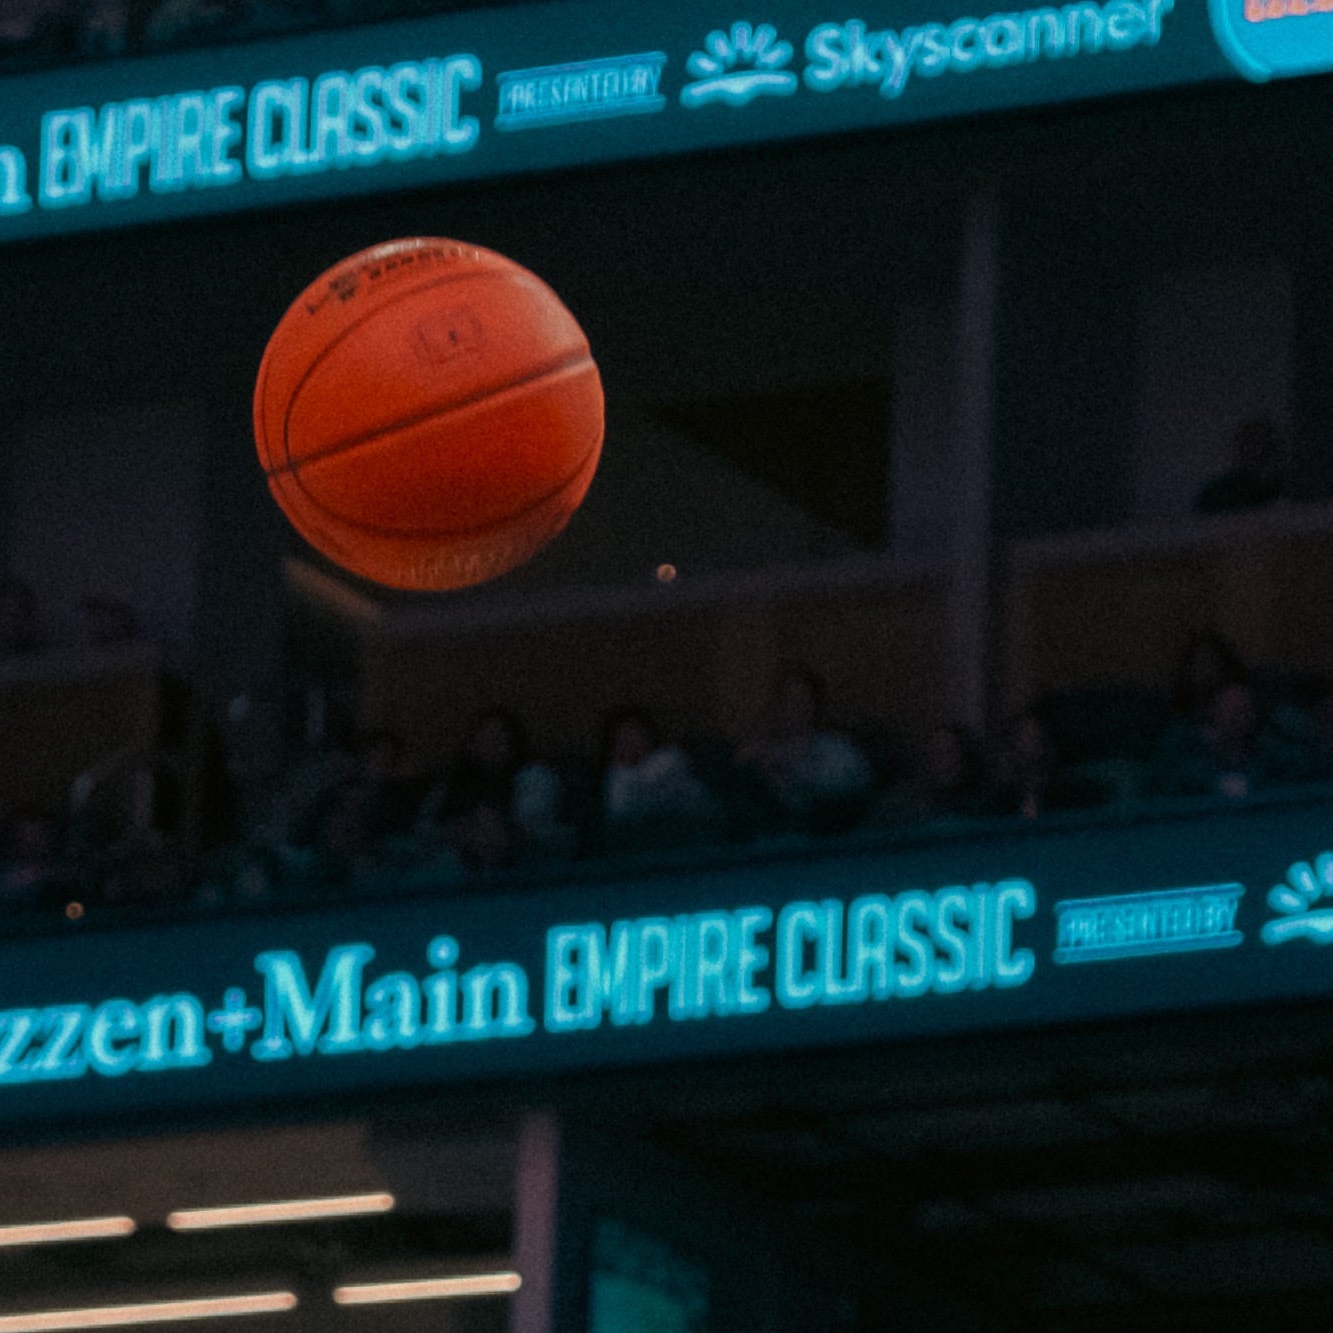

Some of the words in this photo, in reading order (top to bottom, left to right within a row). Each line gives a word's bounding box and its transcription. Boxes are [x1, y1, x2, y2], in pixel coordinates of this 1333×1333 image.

[804, 0, 1171, 98] Skyscanner
[38, 86, 244, 208] EMPIRE
[246, 53, 482, 179] CLASSIC
[544, 905, 773, 1033] EMPIRE
[776, 877, 1036, 1009] CLASSIC
